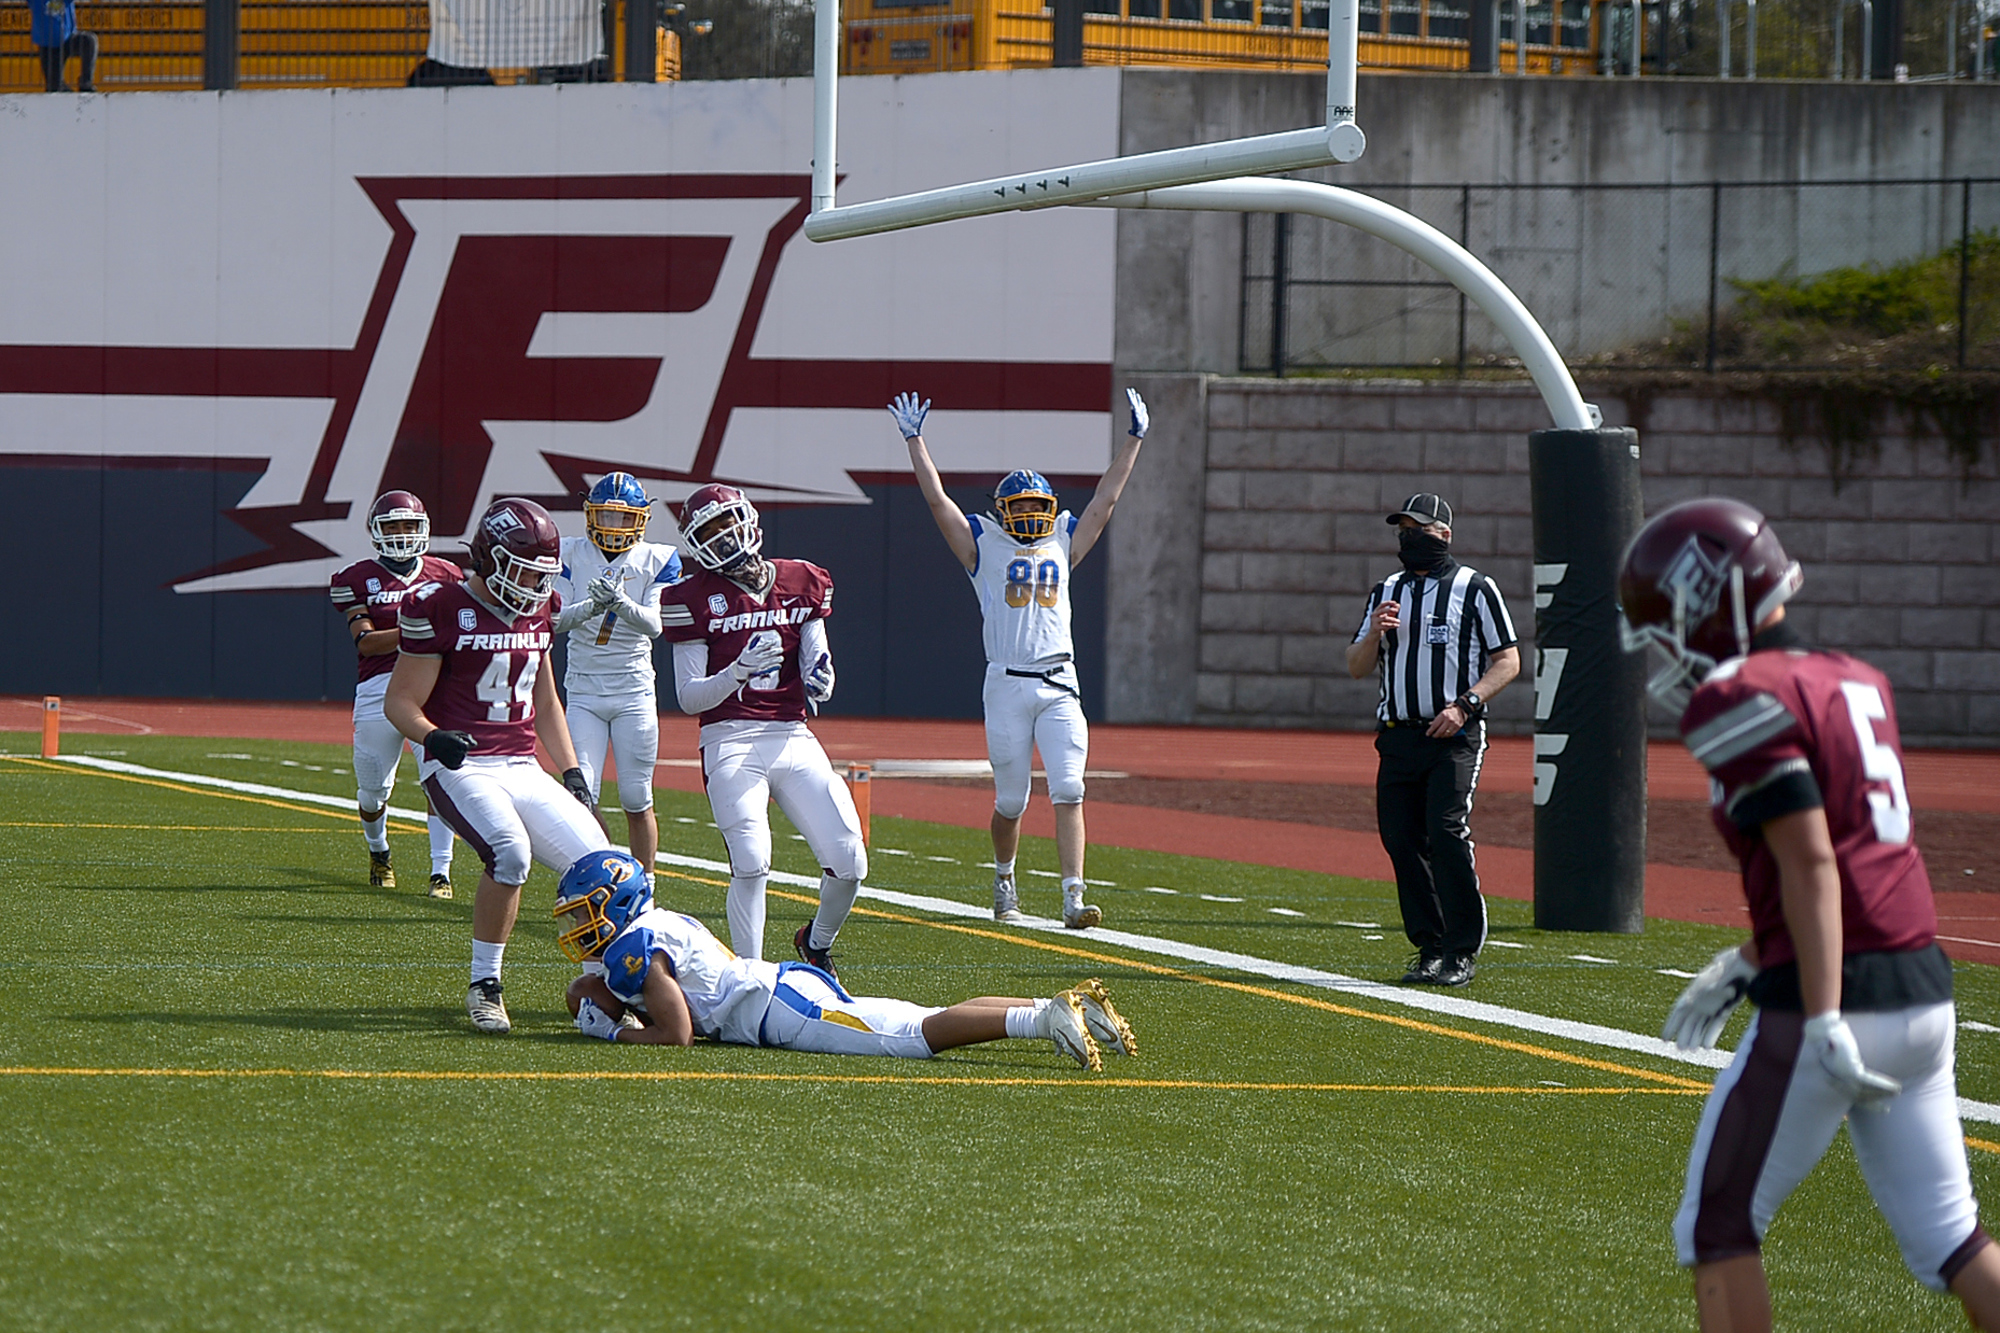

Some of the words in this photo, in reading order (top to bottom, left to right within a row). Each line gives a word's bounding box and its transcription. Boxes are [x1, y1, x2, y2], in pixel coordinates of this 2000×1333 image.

[1005, 559, 1059, 608] 80
[455, 632, 551, 651] FRANKLIN
[708, 607, 813, 633] FRANKLIN
[476, 651, 540, 722] 44
[1840, 679, 1911, 844] 5
